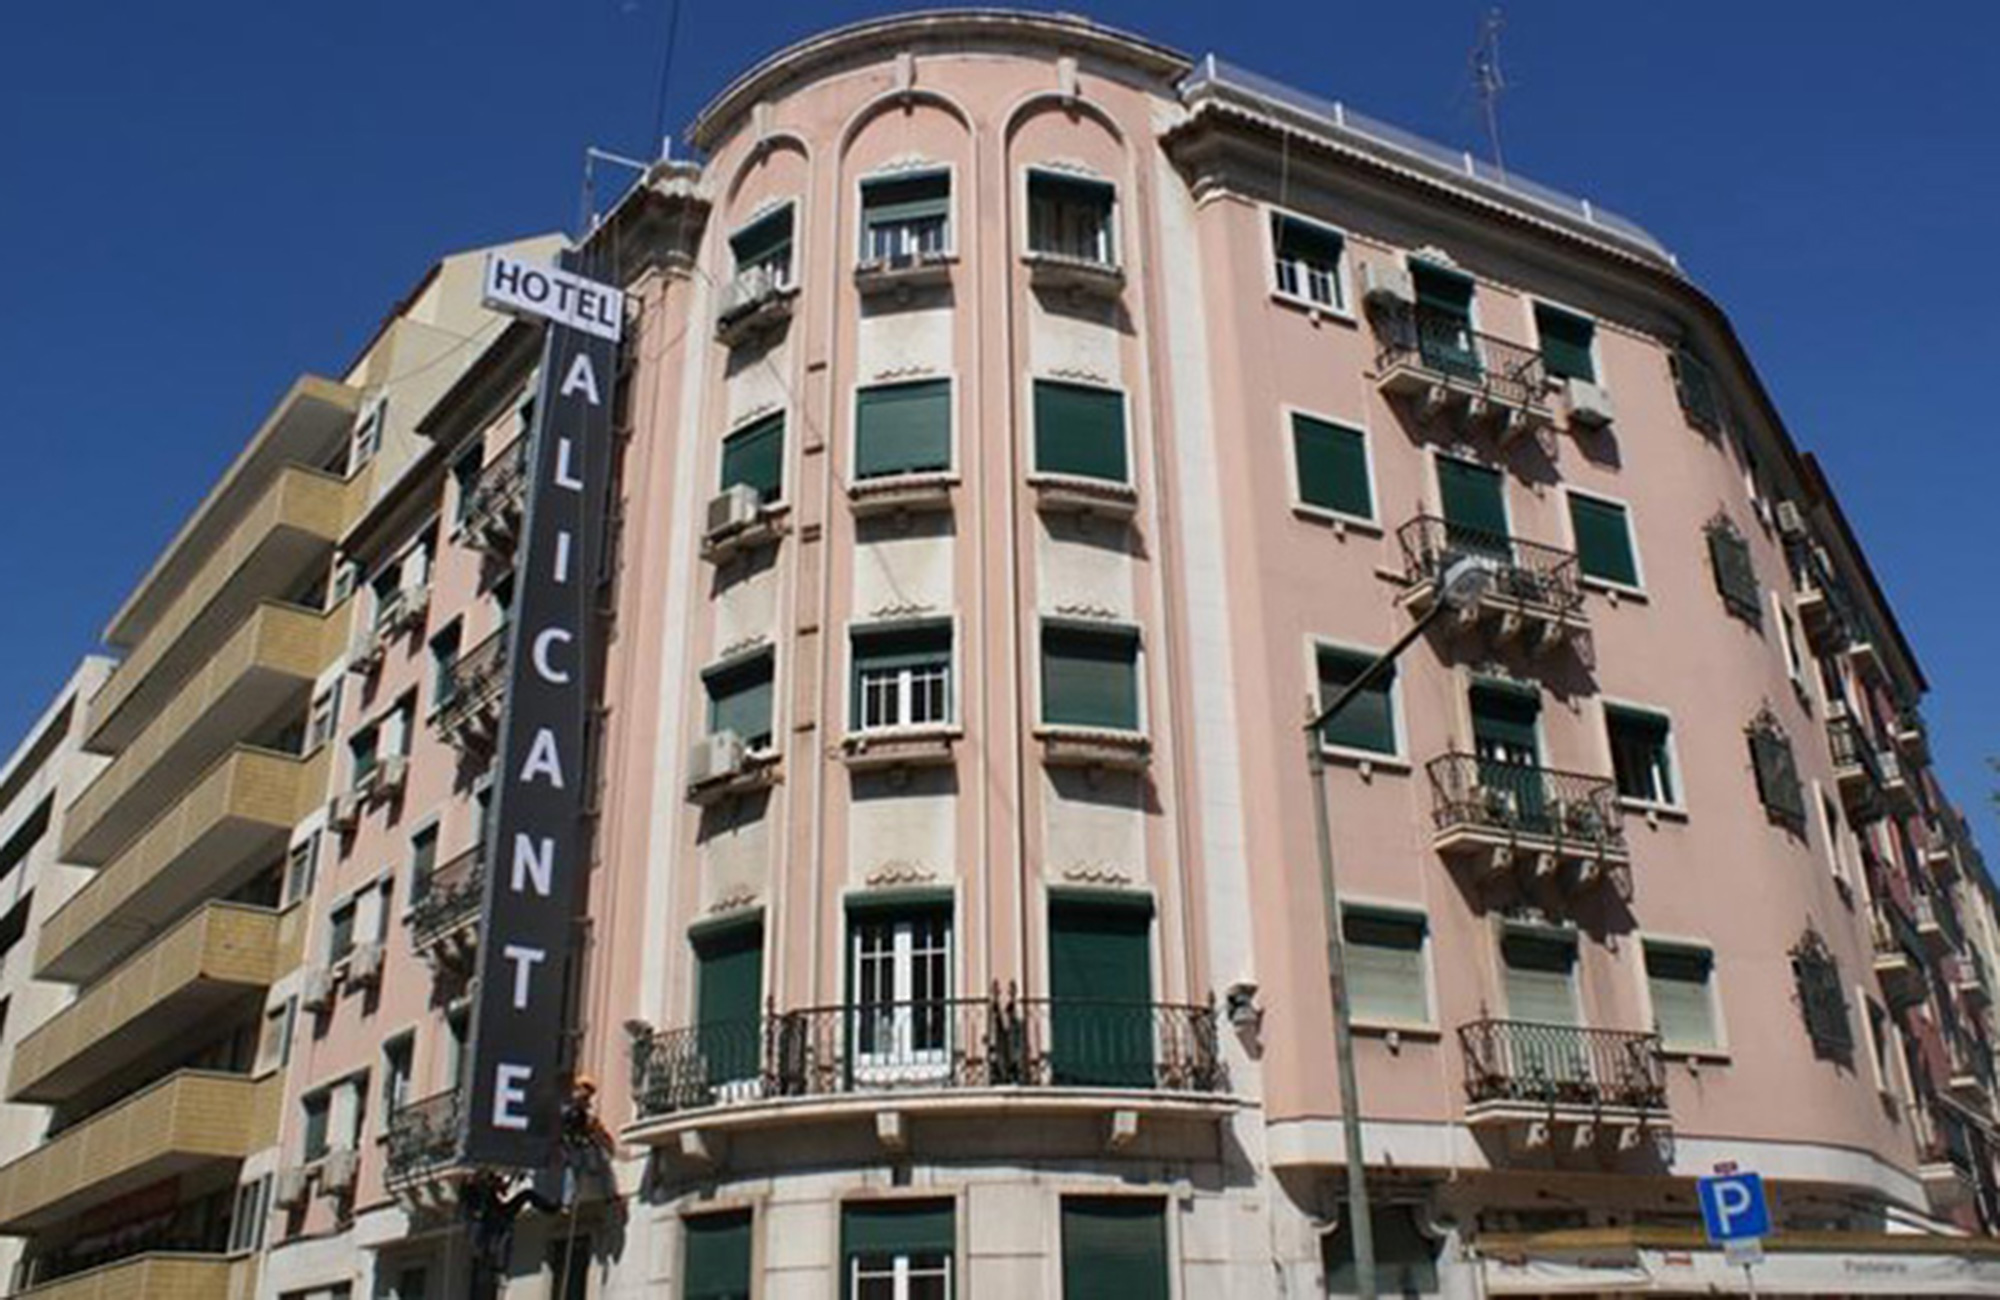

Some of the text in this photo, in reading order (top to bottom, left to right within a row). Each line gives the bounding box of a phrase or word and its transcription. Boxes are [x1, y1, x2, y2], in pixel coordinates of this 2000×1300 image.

[494, 258, 615, 328] HOTEL
[492, 353, 600, 1130] ALICANTE
[1713, 1181, 1751, 1235] P
